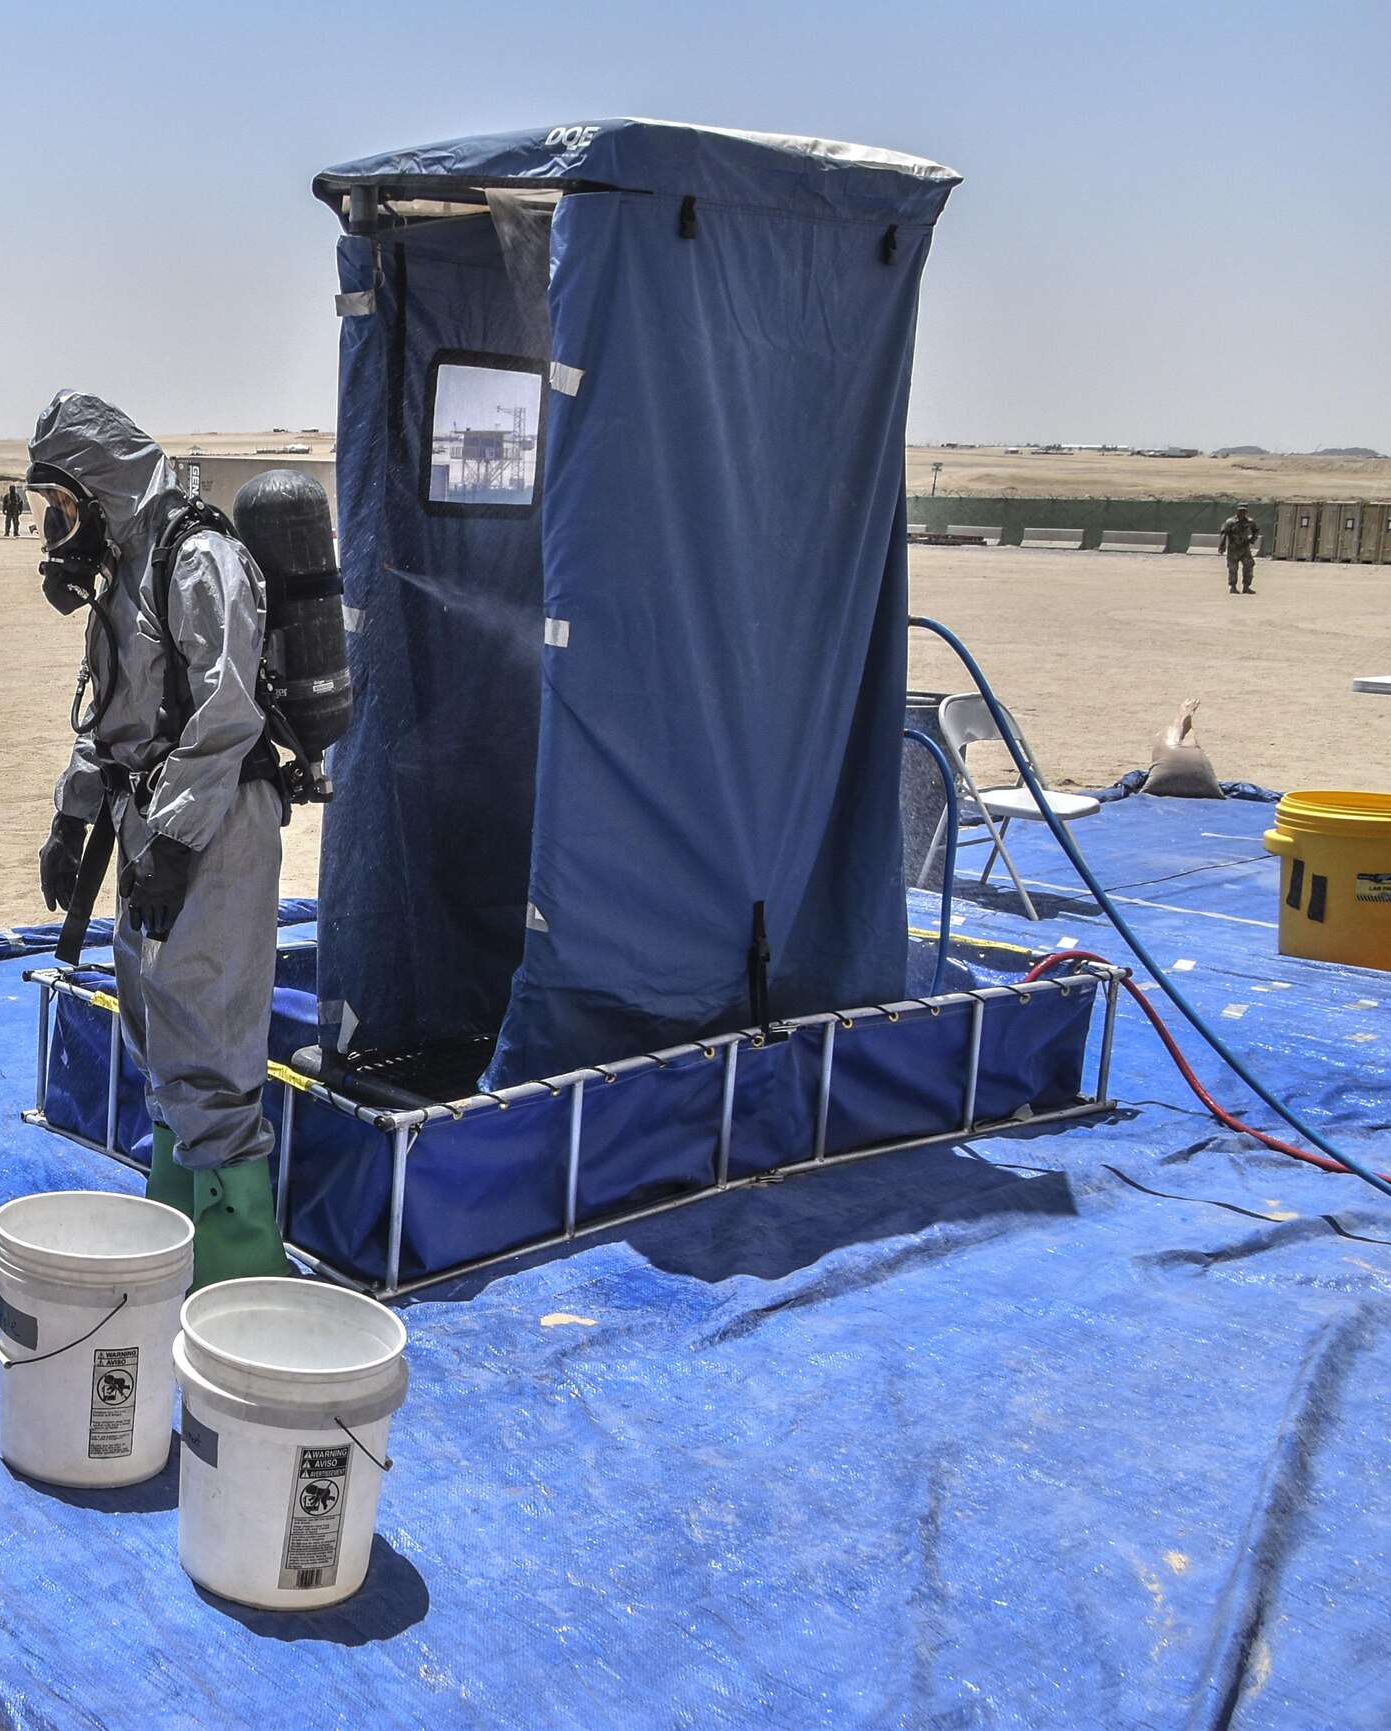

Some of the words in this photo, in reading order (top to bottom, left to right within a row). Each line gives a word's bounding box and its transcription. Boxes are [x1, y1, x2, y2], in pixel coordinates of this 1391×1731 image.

[545, 126, 600, 150] DQE
[274, 688, 289, 699] ger
[106, 1350, 137, 1358] WARNING
[312, 1449, 347, 1459] WARNING
[314, 1459, 338, 1468] AVISO
[309, 1468, 346, 1478] AVERTISSEMENT
